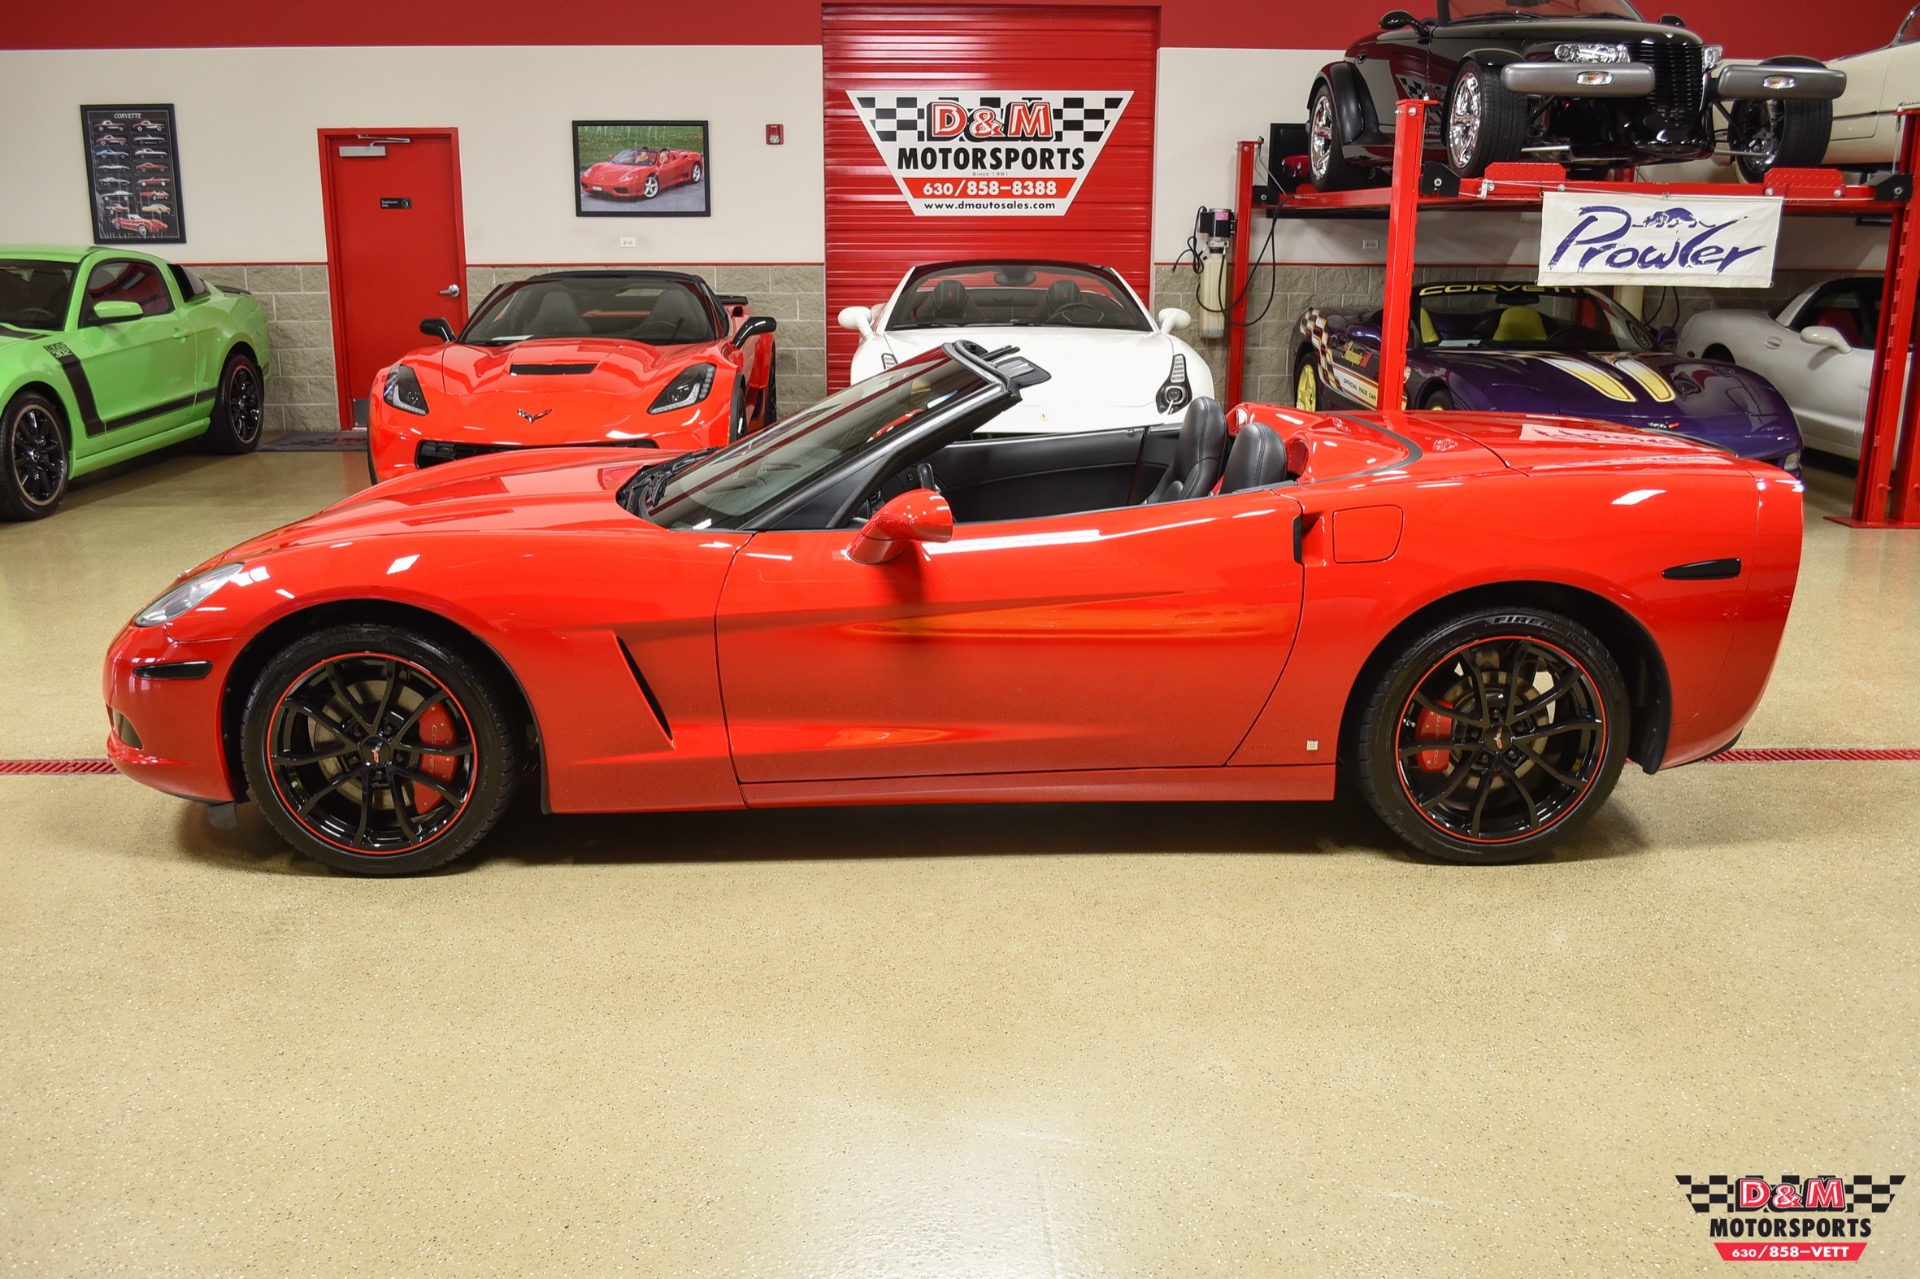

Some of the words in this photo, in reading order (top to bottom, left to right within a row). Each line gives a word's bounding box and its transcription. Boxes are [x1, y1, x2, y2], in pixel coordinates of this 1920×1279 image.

[929, 102, 1054, 140] D&M
[897, 147, 1086, 171] MOTORSPORTS
[922, 179, 1058, 197] 630/858-8388
[923, 200, 1056, 211] www.dmautosales.com
[1547, 205, 1768, 276] Prowler
[43, 342, 67, 351] BOSS
[52, 349, 73, 358] 302
